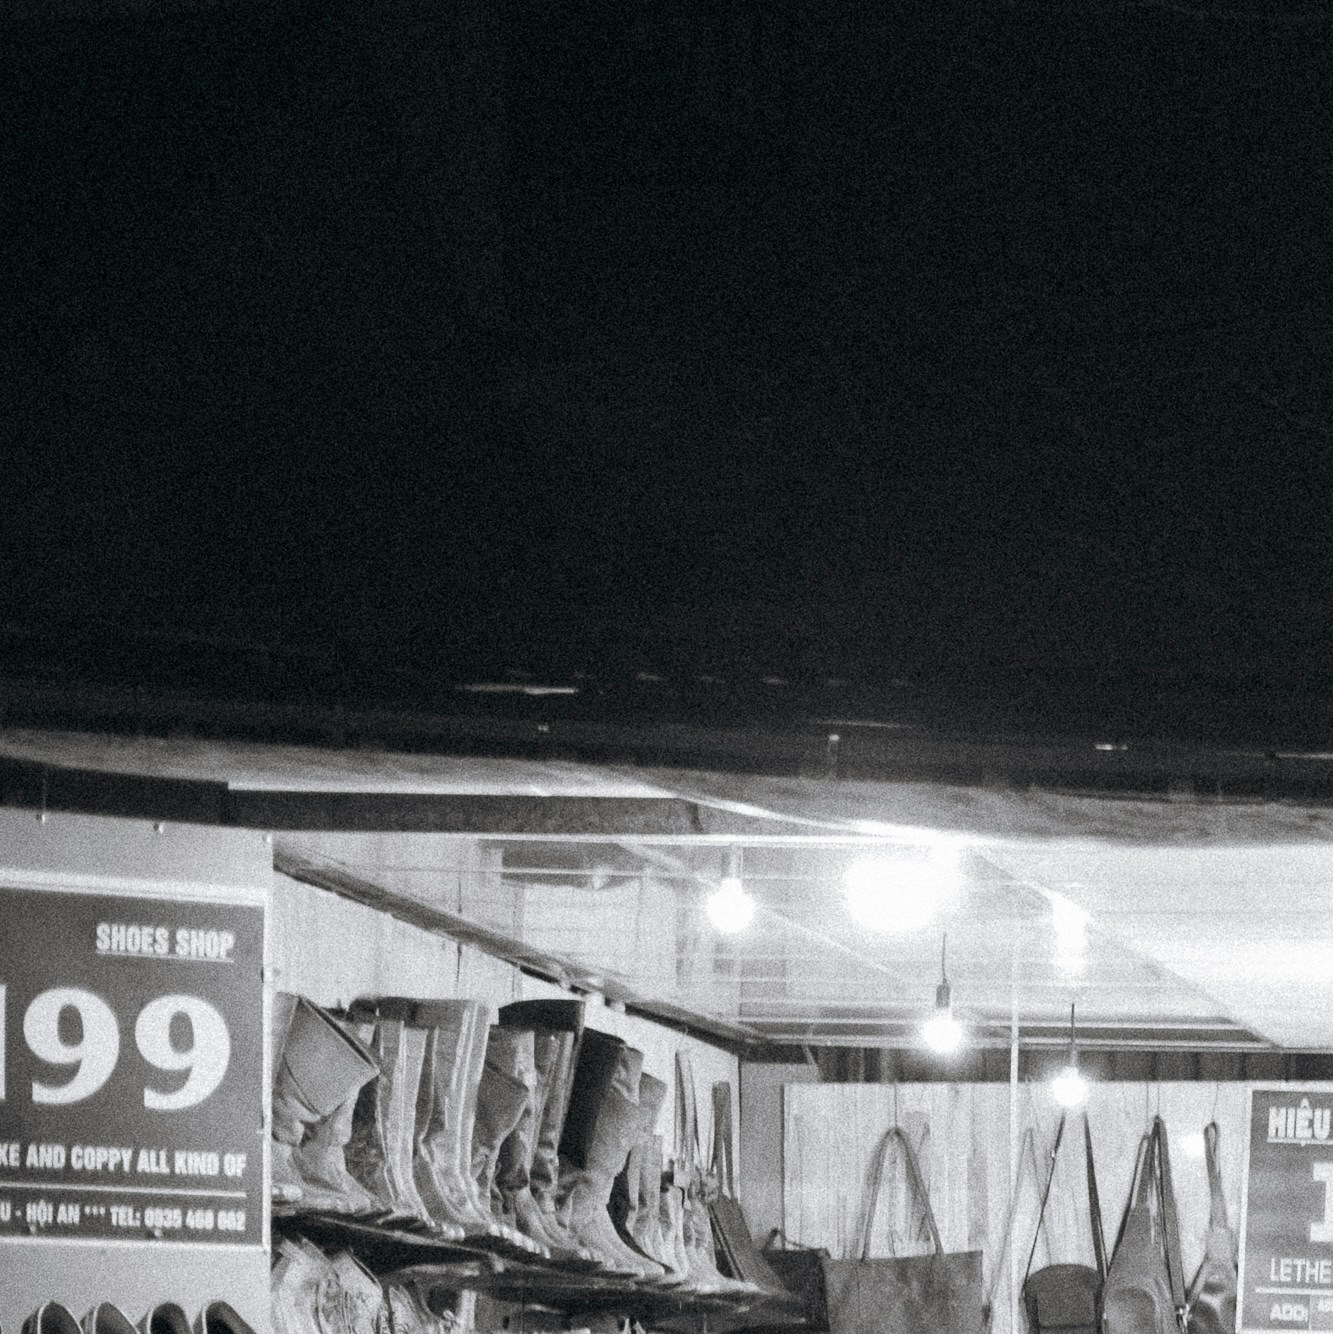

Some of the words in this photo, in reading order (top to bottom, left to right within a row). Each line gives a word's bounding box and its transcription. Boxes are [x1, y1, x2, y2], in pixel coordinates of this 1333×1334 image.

[97, 923, 170, 955] SHOES
[175, 928, 236, 959] SHOP
[0, 984, 232, 1111] 99
[1267, 1097, 1332, 1148] HIỆU
[25, 1141, 67, 1170] AND
[70, 1144, 134, 1174] COPPY
[136, 1147, 171, 1176] ALL
[173, 1149, 220, 1178] KIND
[223, 1151, 248, 1180] OF
[56, 1201, 81, 1226] AN
[109, 1203, 142, 1228] TEL:
